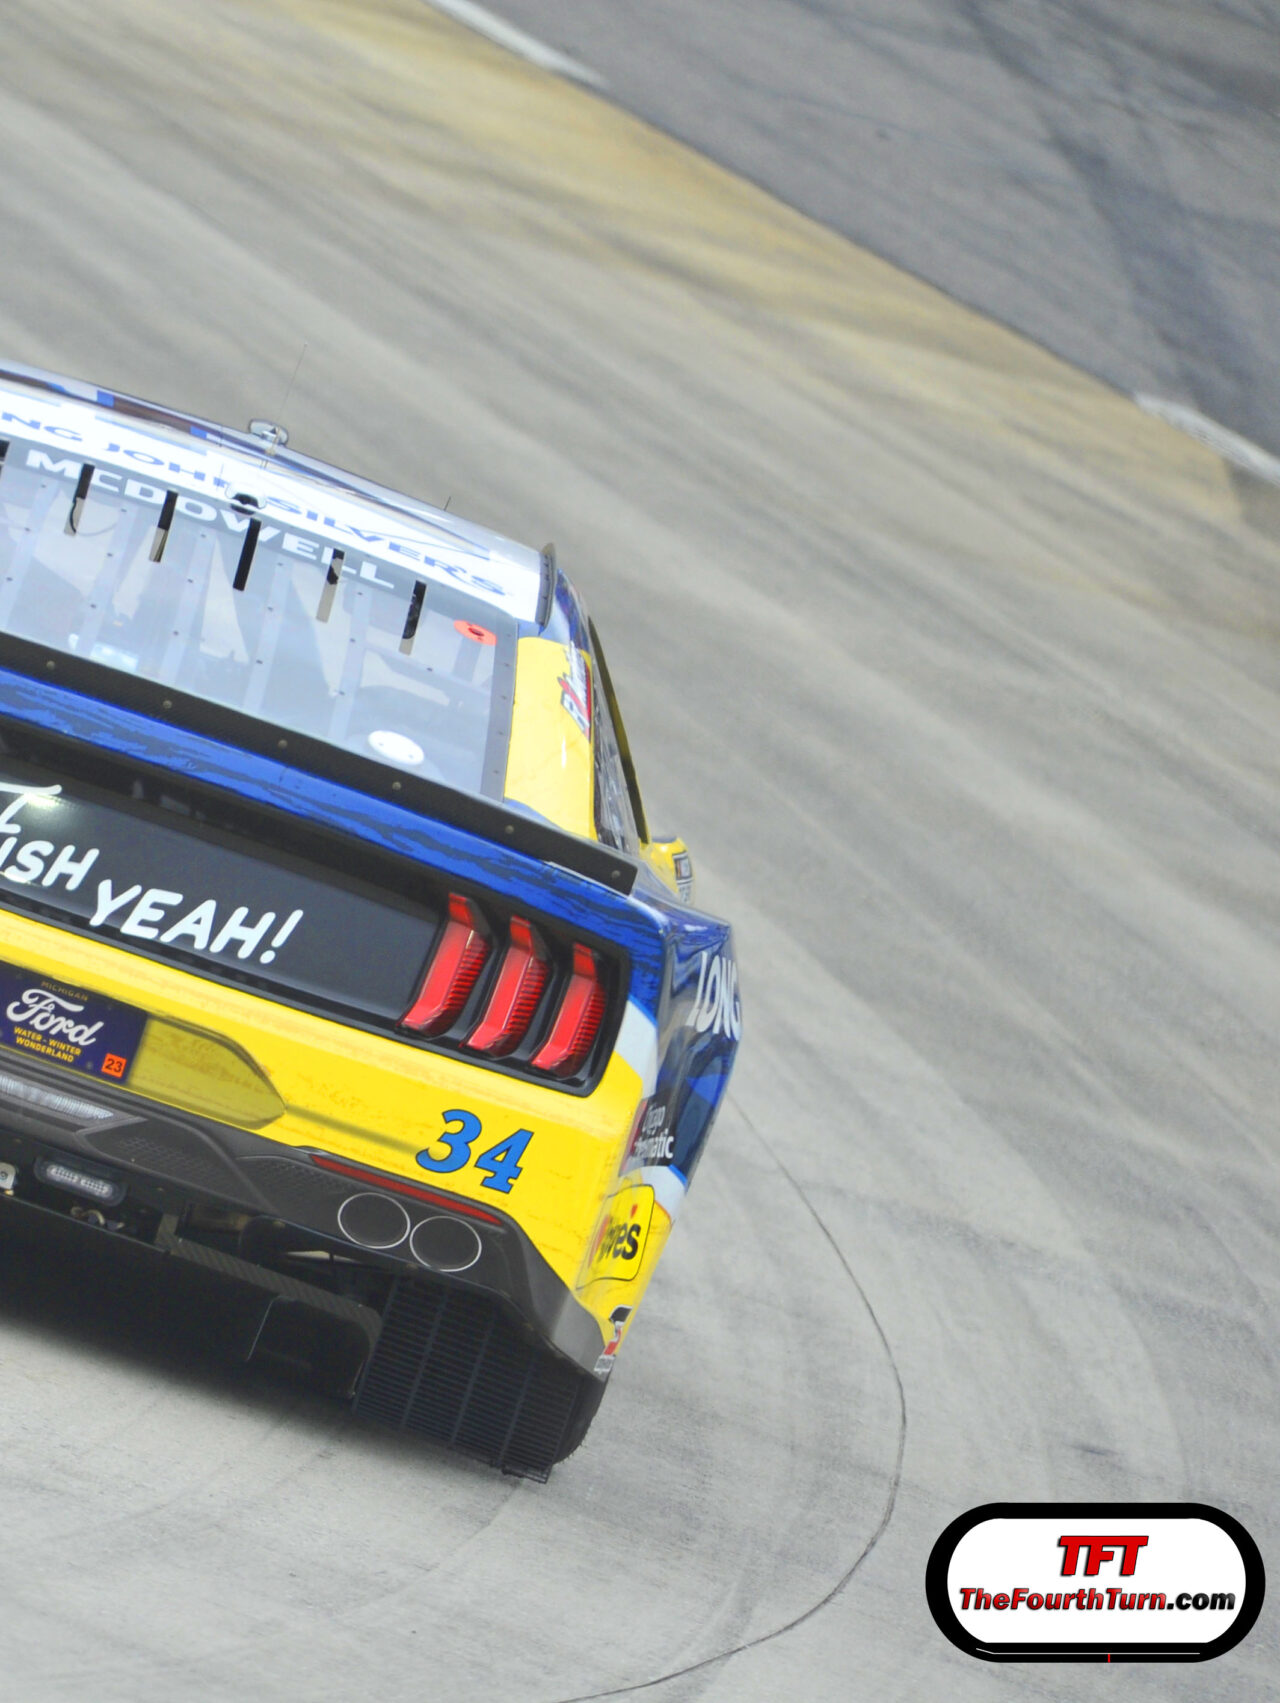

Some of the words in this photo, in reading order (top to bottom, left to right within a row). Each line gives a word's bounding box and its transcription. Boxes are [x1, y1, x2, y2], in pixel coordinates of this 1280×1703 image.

[89, 879, 304, 965] YEAH!
[40, 980, 89, 1003] MICHIGAN
[6, 988, 104, 1046] Ford
[13, 1026, 43, 1042] WATER
[48, 1038, 82, 1056] WINTER
[15, 1036, 74, 1063] WONDERLAND
[105, 1057, 123, 1074] 23
[415, 1108, 534, 1194] 34
